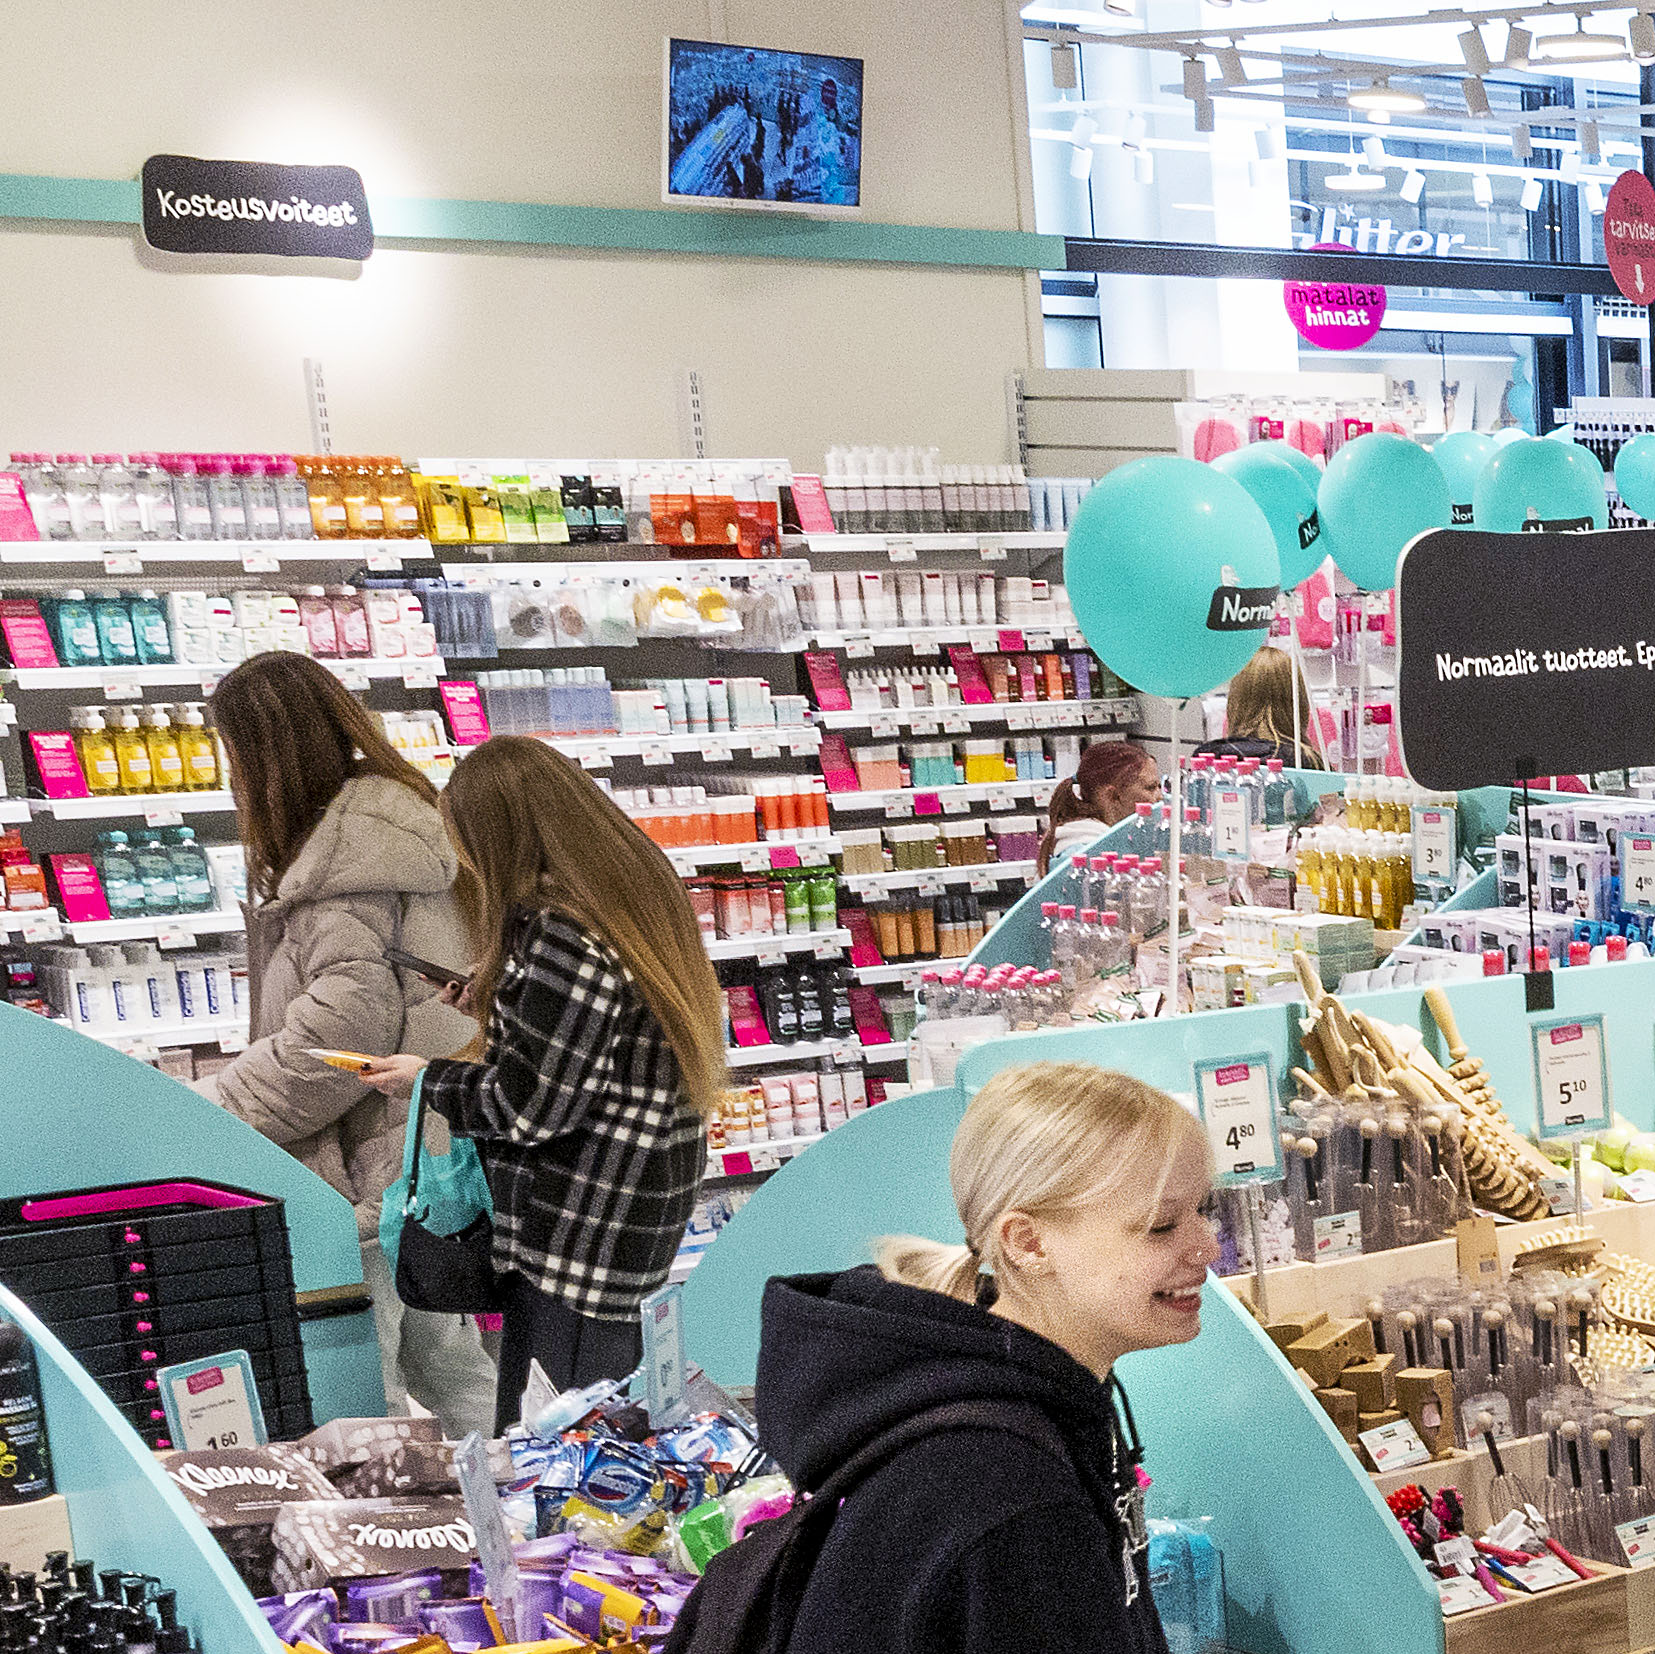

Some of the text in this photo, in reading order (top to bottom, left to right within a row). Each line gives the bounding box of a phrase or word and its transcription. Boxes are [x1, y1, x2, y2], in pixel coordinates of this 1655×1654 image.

[156, 187, 359, 226] Kosteusvoiteet
[1291, 282, 1380, 307] matalat
[1305, 305, 1370, 327] hinnat
[1450, 510, 1474, 522] Nor
[1435, 648, 1538, 682] Normaalit
[1541, 644, 1634, 674] tuotteet.
[168, 1461, 299, 1497] Kleenex
